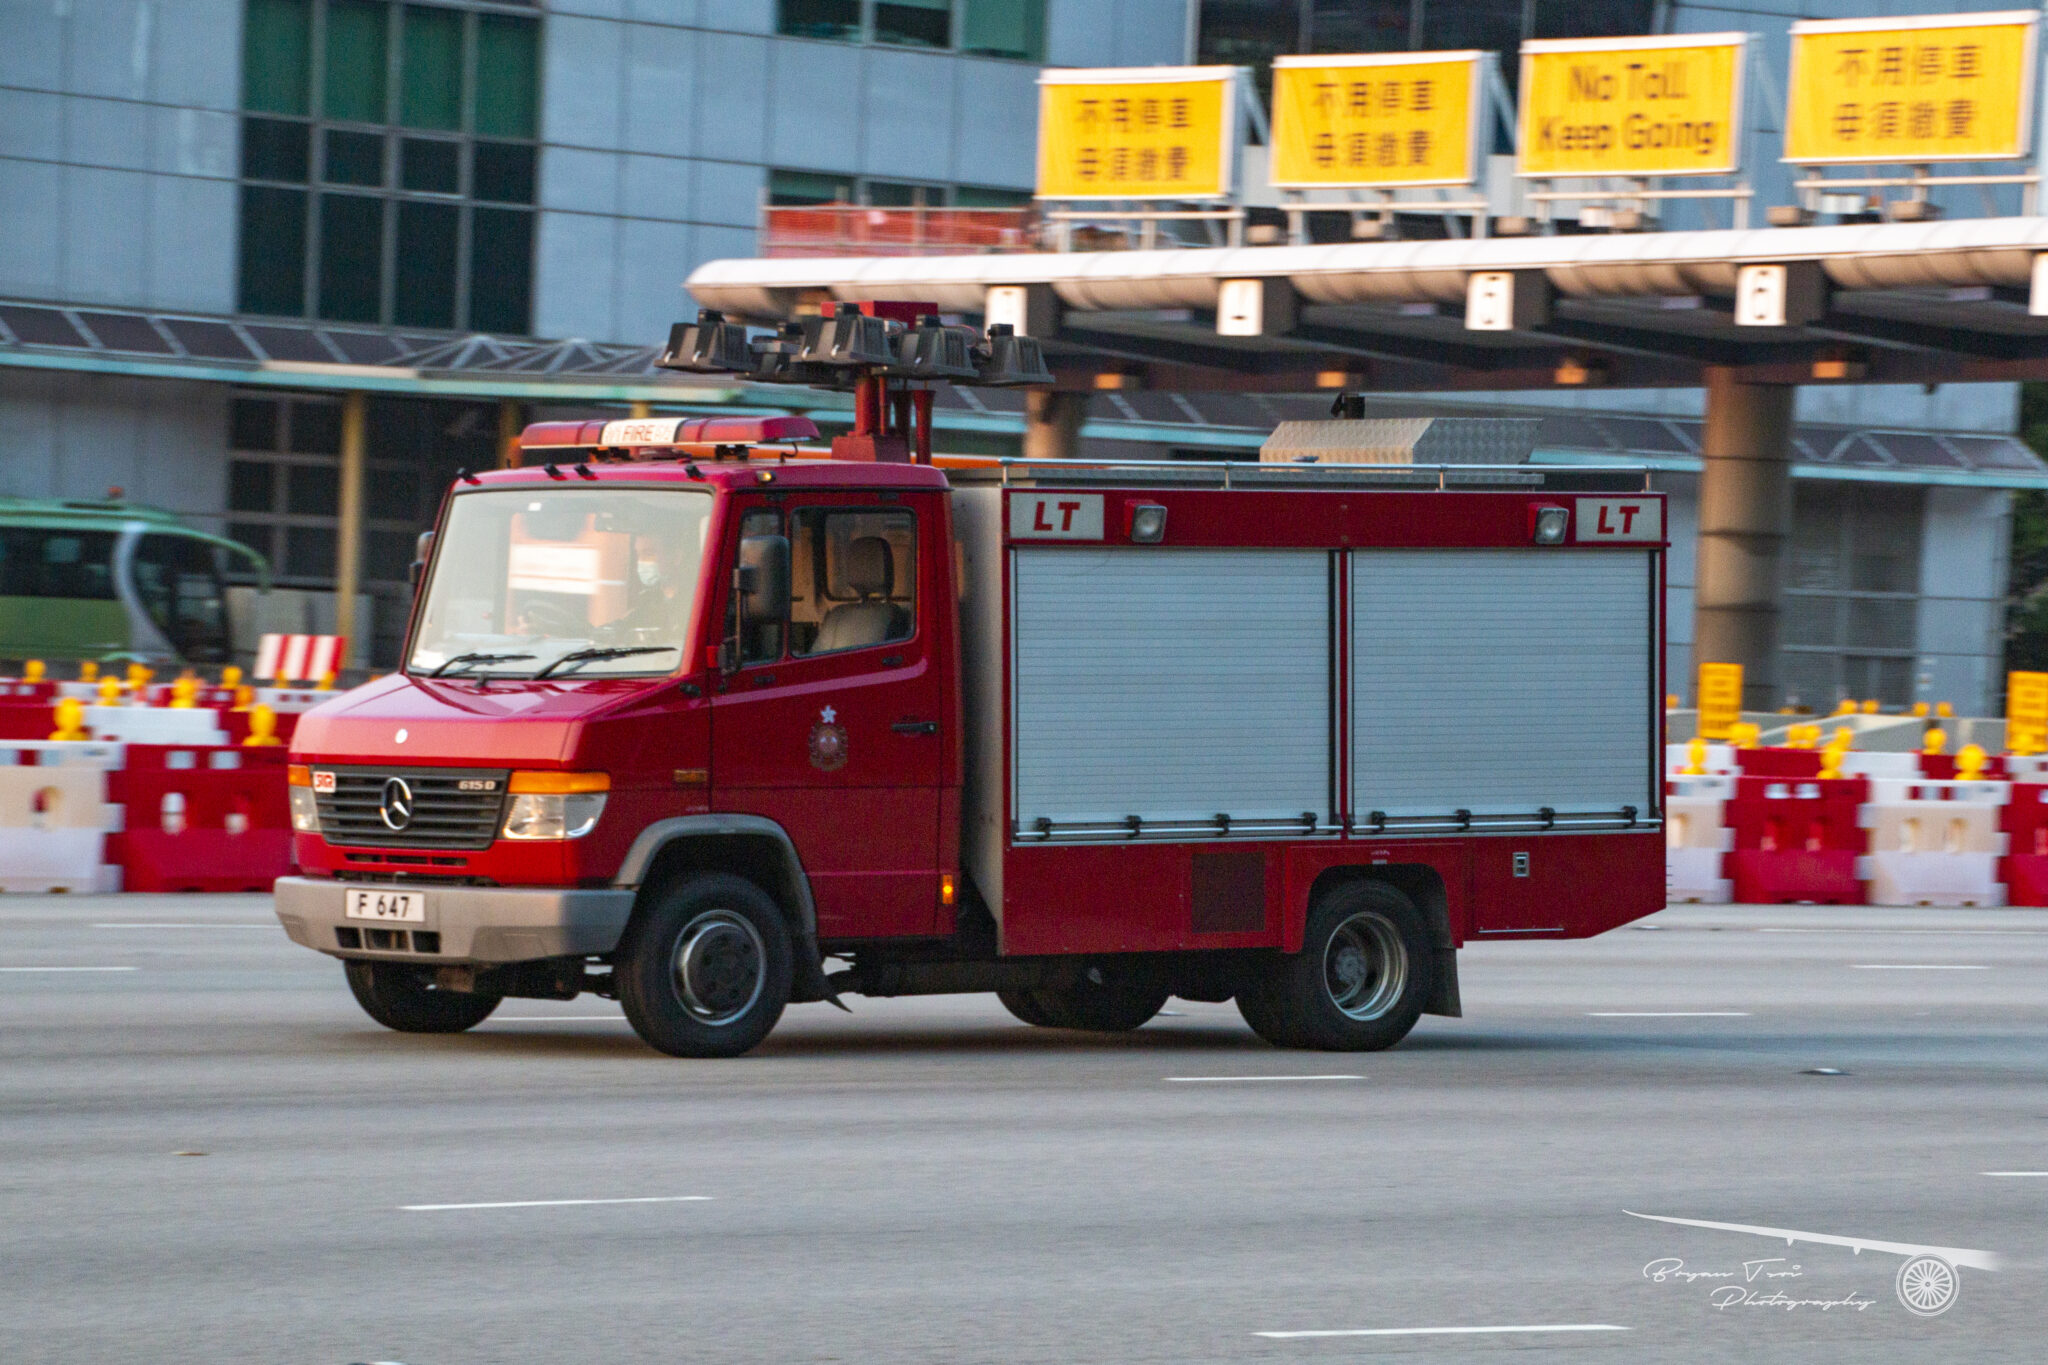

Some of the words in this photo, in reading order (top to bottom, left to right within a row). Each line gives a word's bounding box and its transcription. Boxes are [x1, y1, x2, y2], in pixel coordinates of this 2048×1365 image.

[1569, 65, 1616, 101] No
[1625, 61, 1689, 99] Toll
[1833, 44, 1984, 87] 不用停車
[1075, 98, 1193, 135] 不用停車
[1311, 80, 1437, 117] 不用停車
[1536, 115, 1614, 159] Keep
[1622, 112, 1718, 156] Going
[622, 424, 656, 442] FIRE
[1033, 501, 1081, 532] LT
[1597, 505, 1640, 534] LT
[358, 893, 368, 915] F
[377, 894, 410, 918] 647
